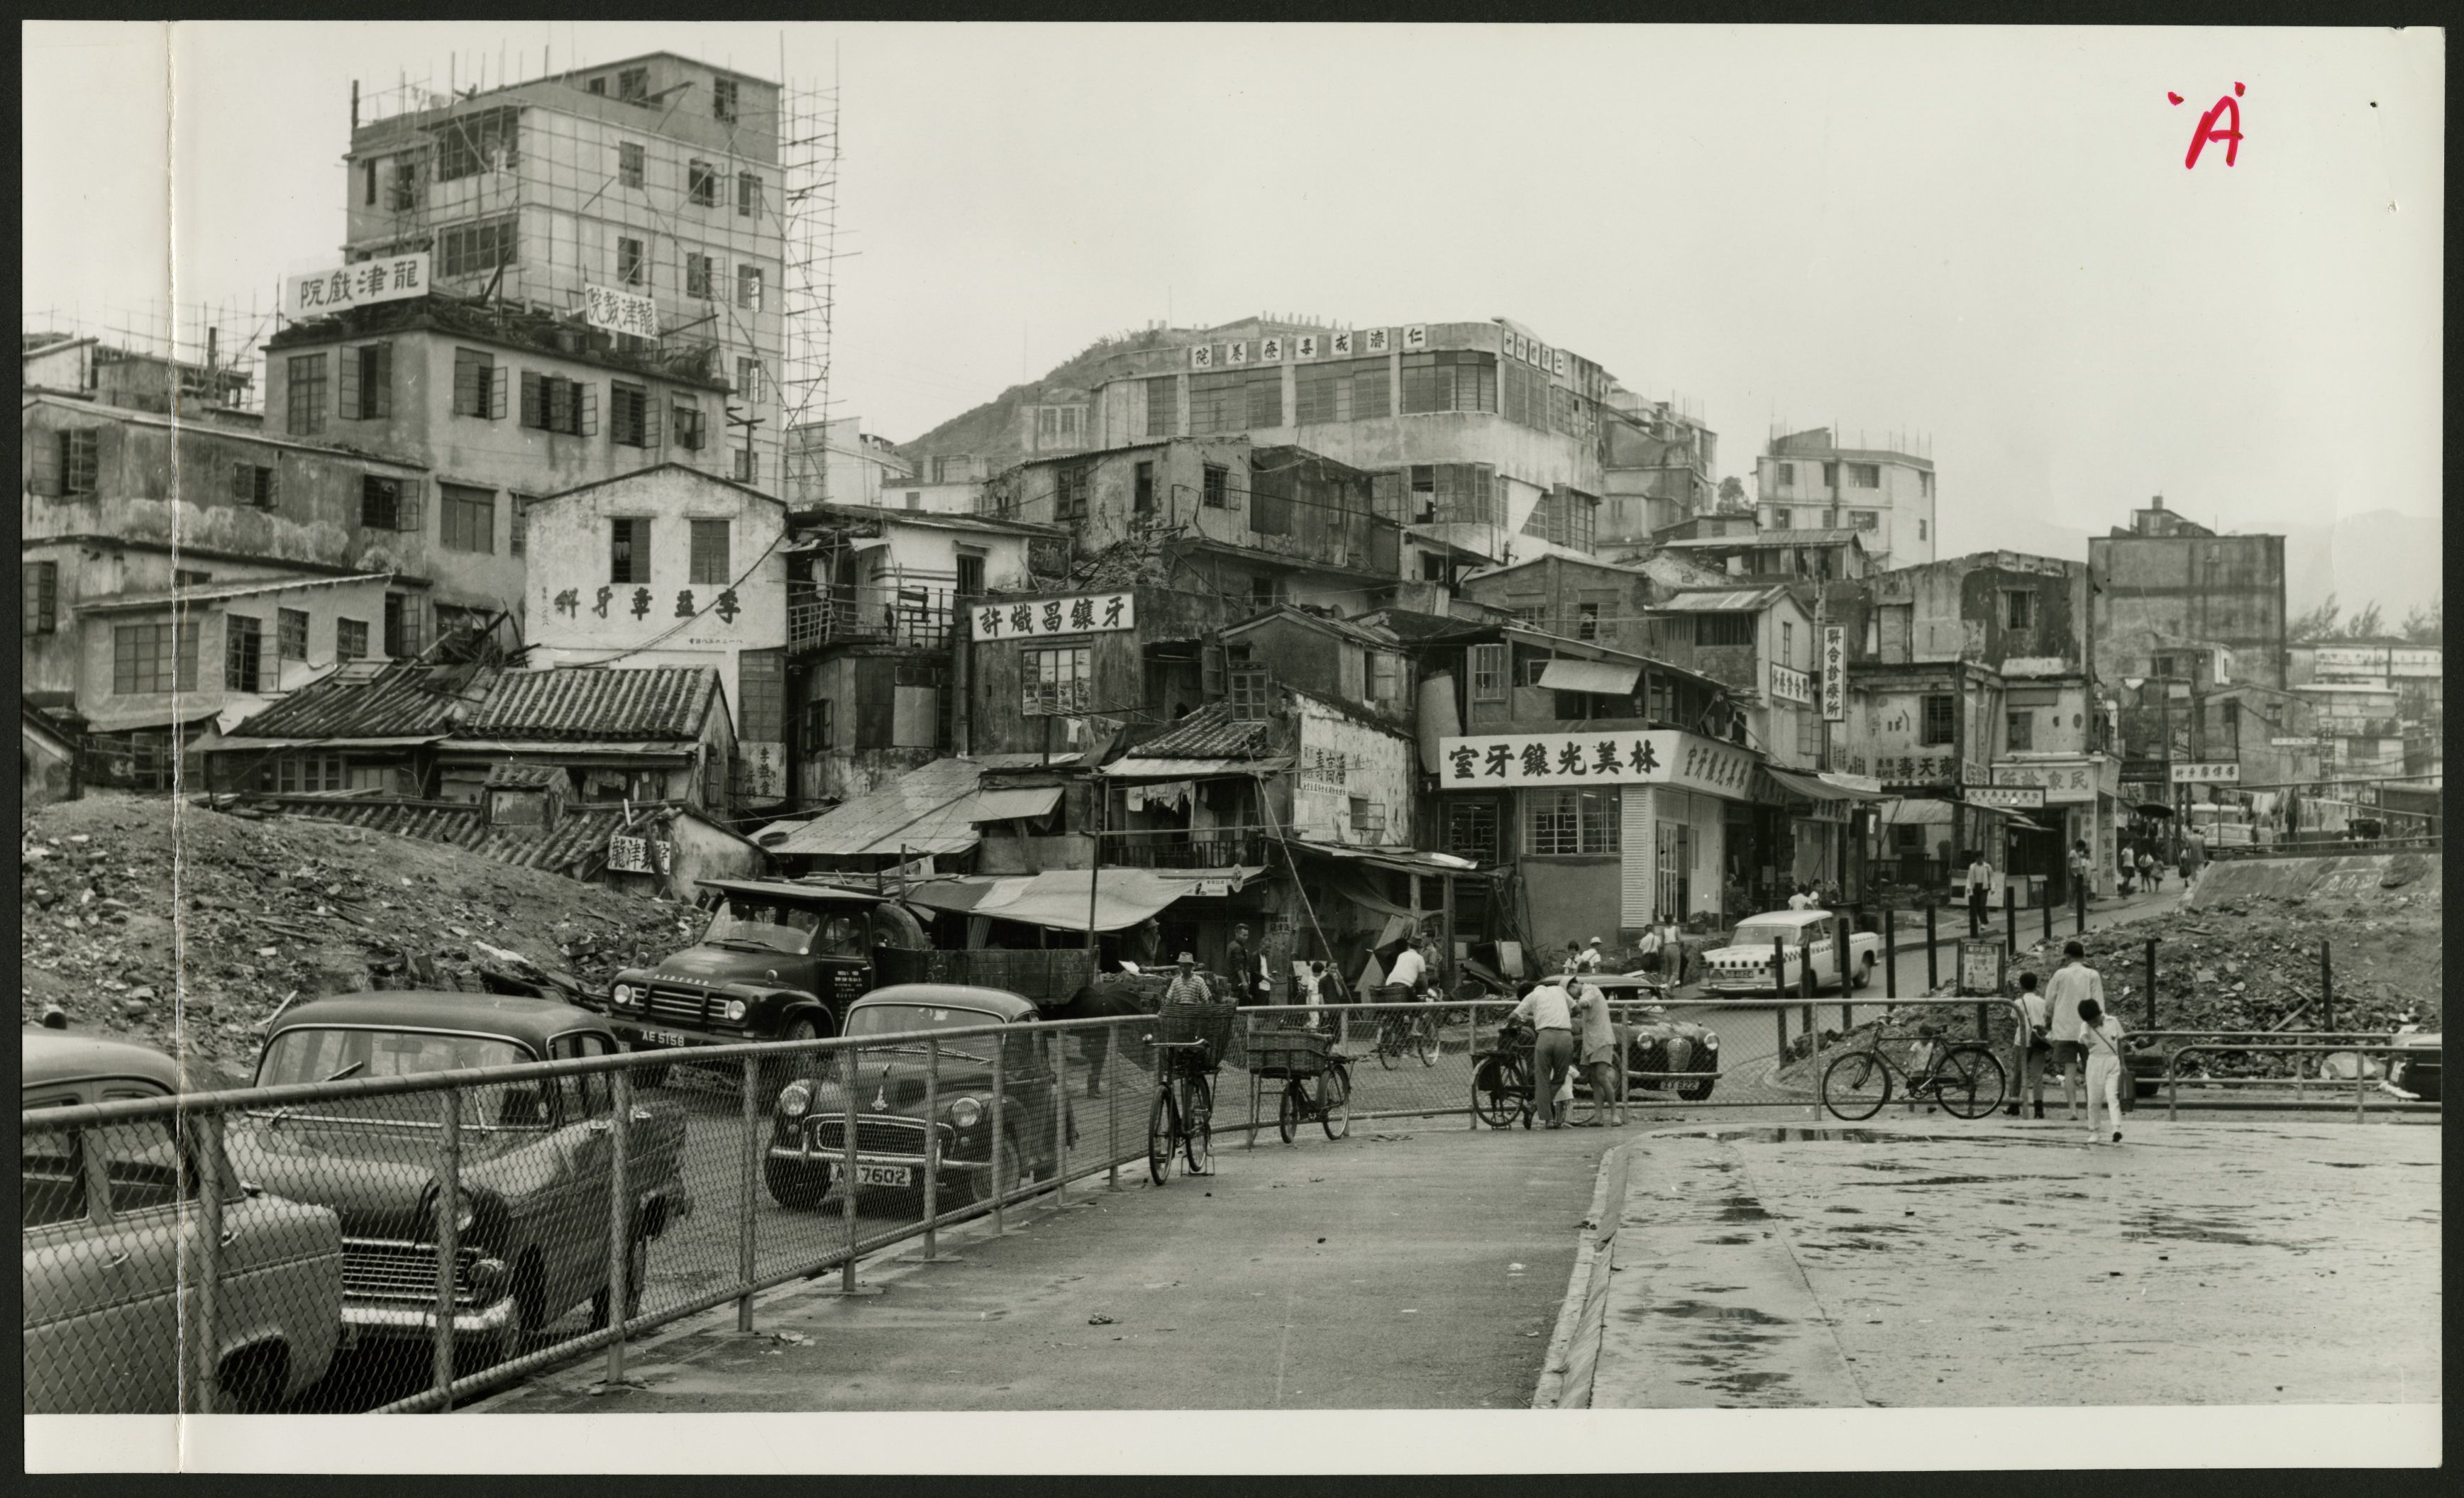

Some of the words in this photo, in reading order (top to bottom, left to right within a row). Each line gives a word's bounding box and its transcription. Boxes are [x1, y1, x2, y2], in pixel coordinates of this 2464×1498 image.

[300, 259, 419, 308] 龍津戲院
[1195, 328, 1423, 366] 仁濟戒毒療養院
[979, 596, 1125, 638] 許熾昌鑲牙
[1825, 628, 1841, 718] 聯合診療所
[1448, 740, 1660, 779] 林美光鑲牙室
[642, 1030, 655, 1042] AE
[658, 1032, 685, 1047] 5158
[859, 1167, 906, 1184] 7602
